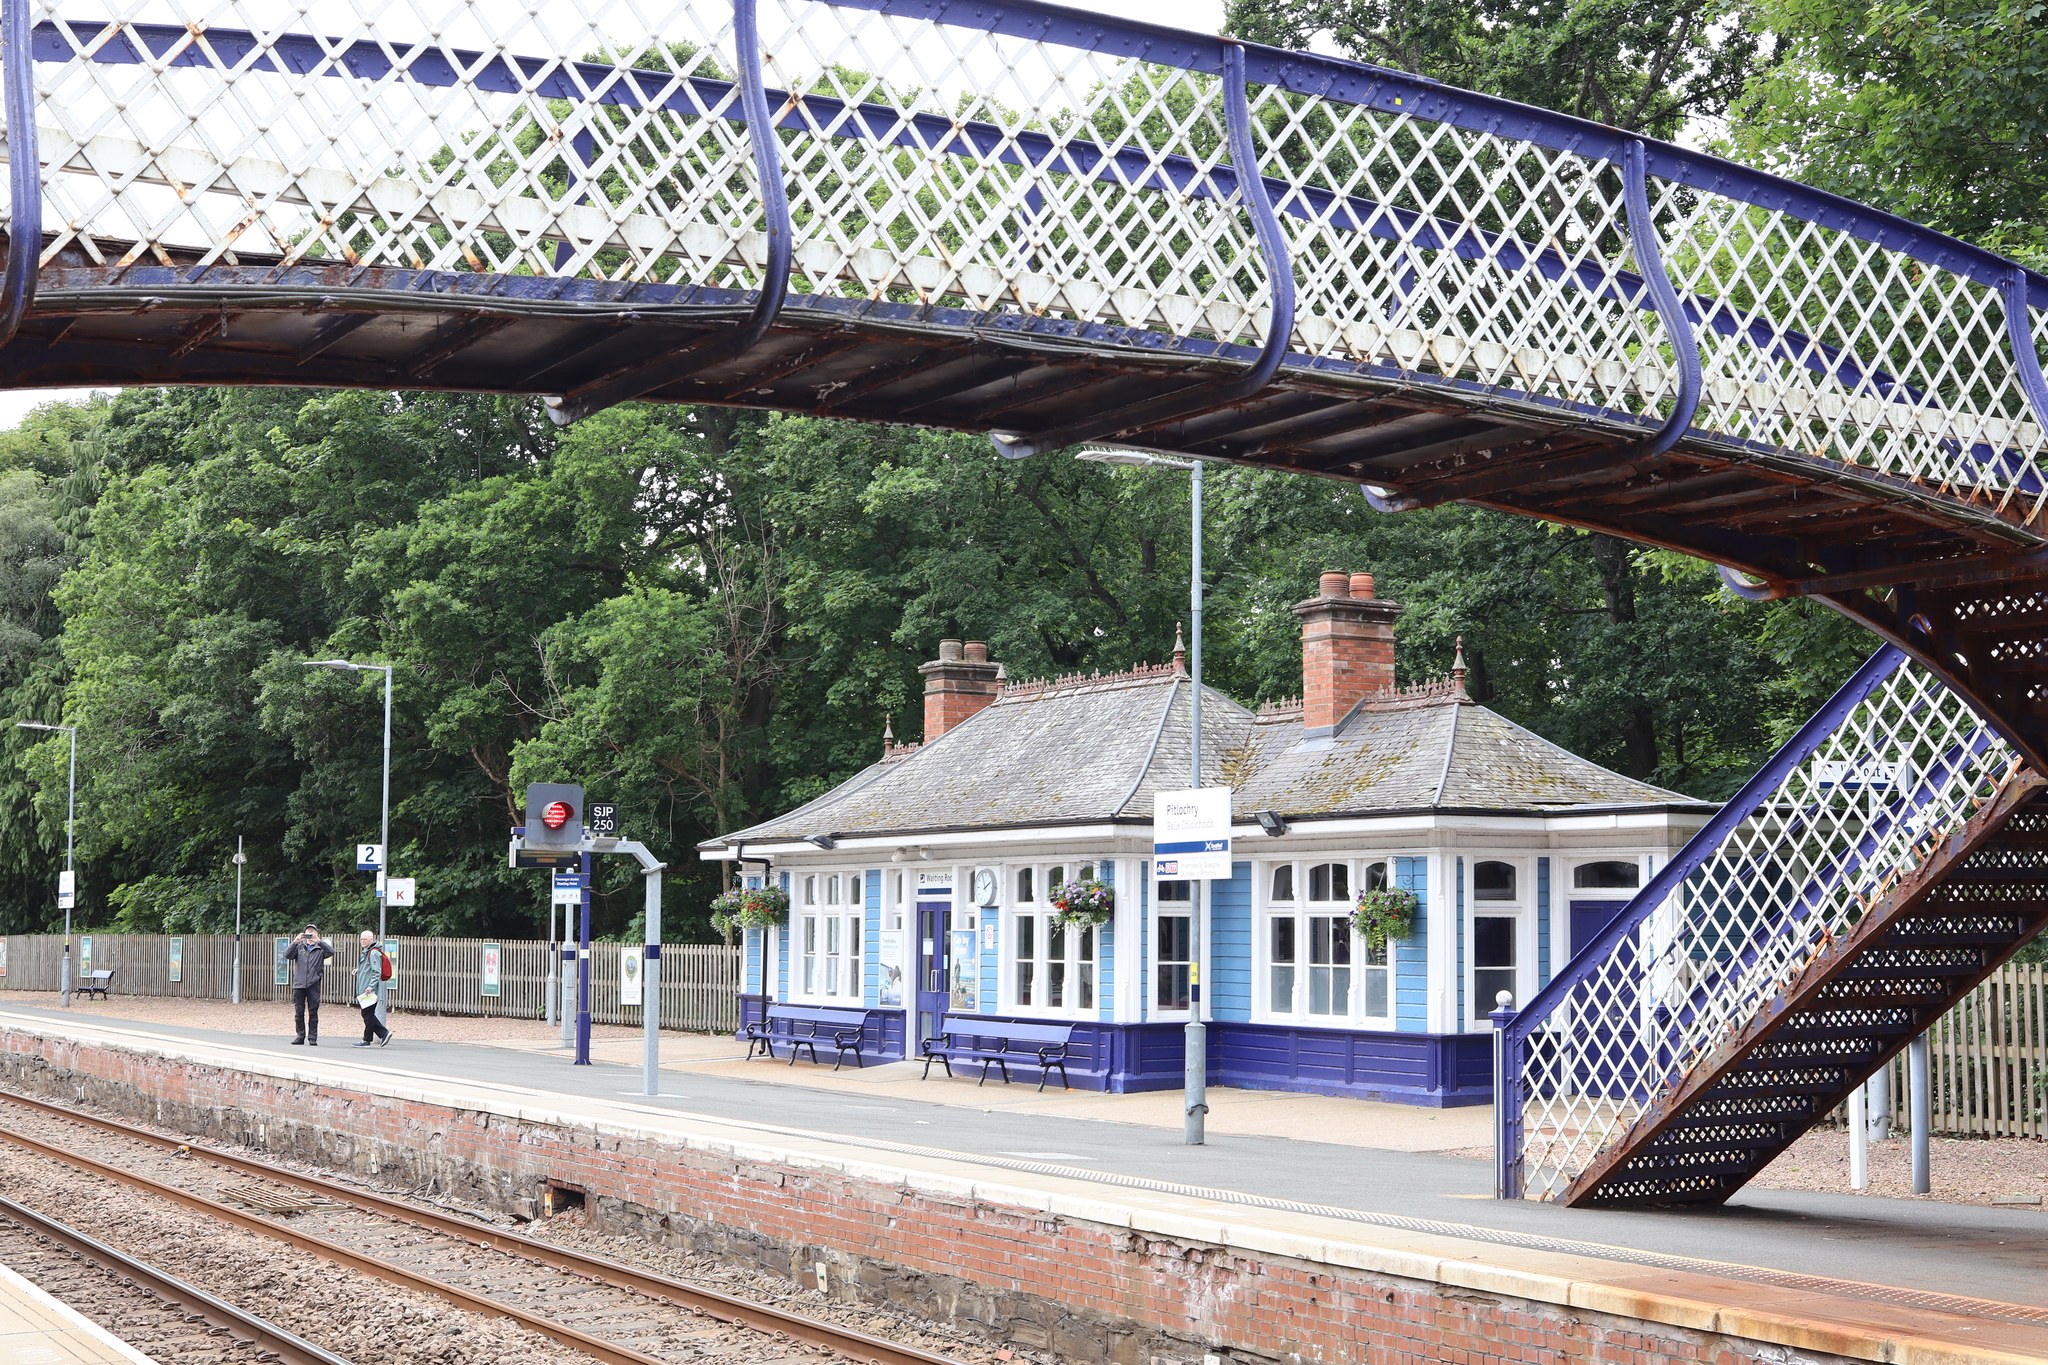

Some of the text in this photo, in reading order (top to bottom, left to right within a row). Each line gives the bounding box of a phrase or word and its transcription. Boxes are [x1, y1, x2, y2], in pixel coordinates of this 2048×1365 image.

[1863, 765, 1881, 777] ot
[593, 806, 614, 817] SJP
[1166, 803, 1199, 818] Pitlochry
[593, 819, 614, 831] 250
[365, 846, 375, 862] 2
[926, 873, 944, 884] Waiting
[396, 890, 405, 900] K
